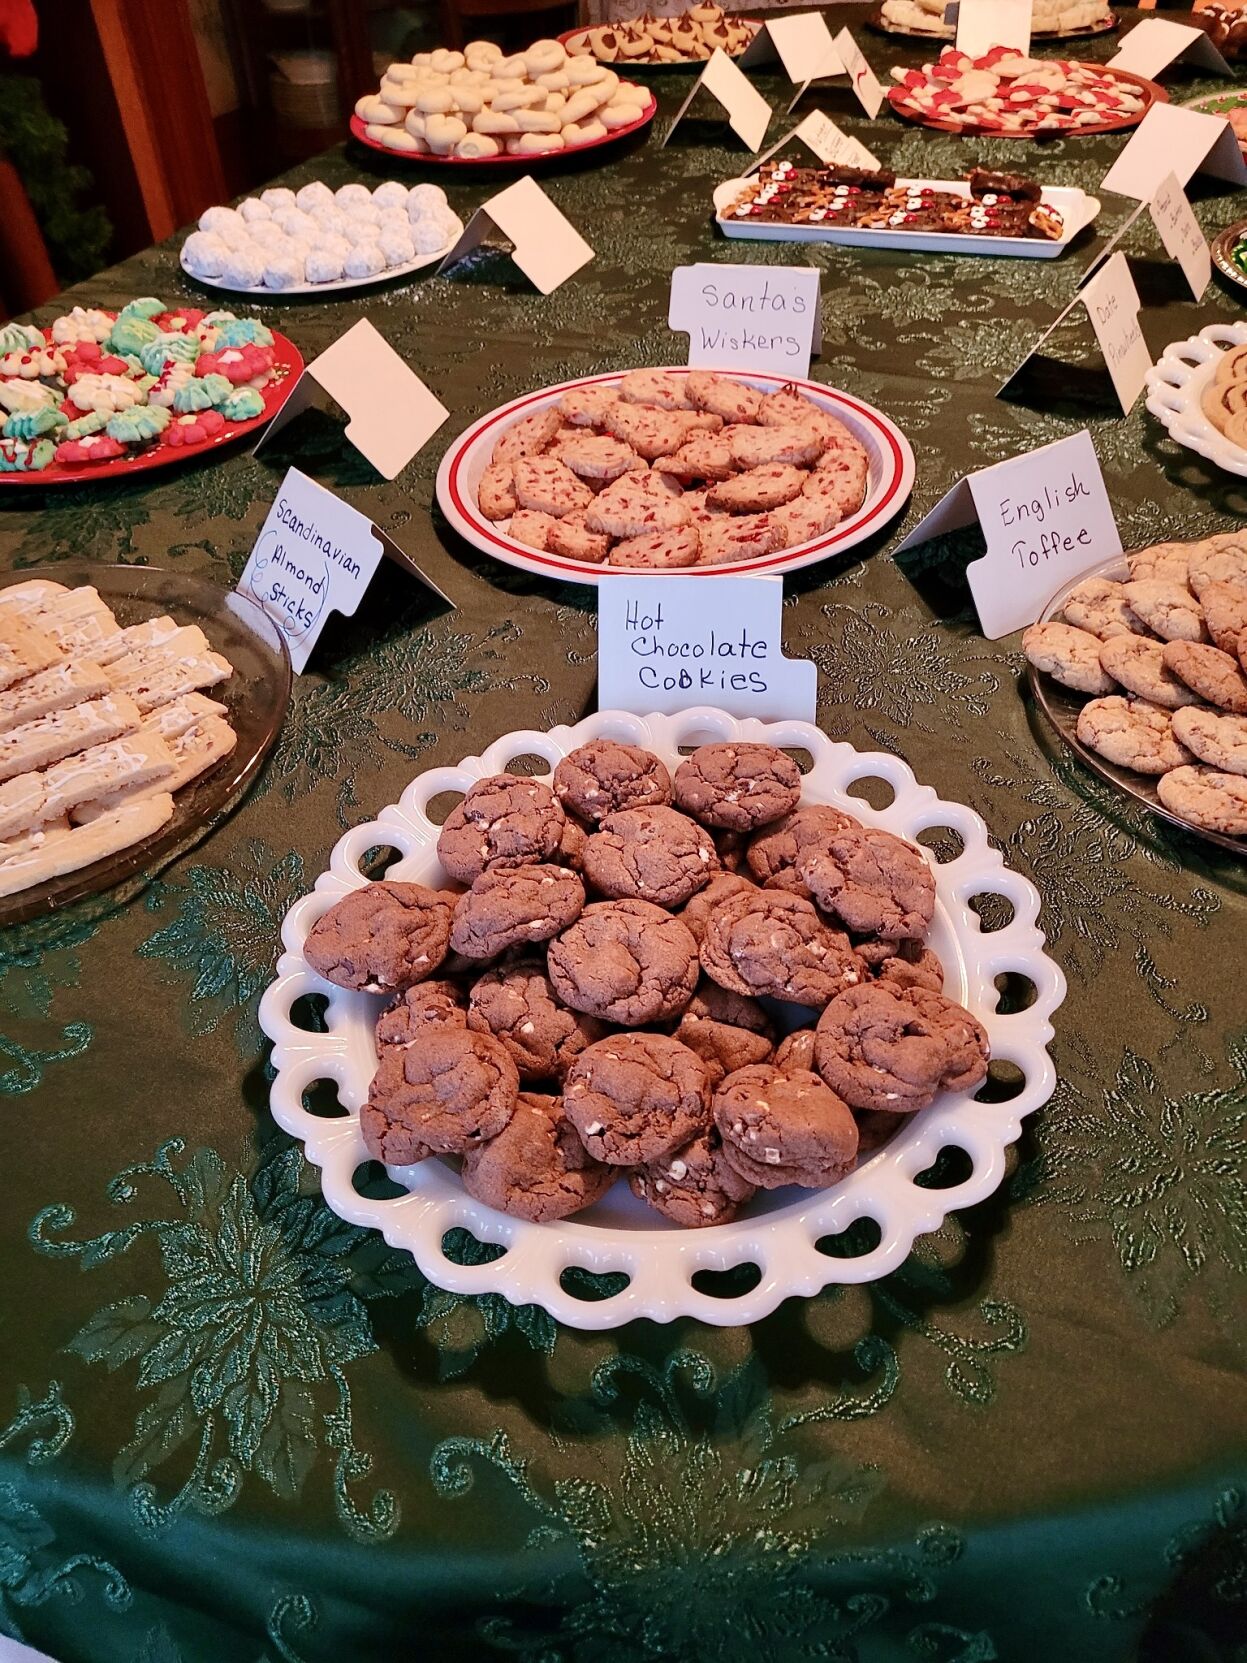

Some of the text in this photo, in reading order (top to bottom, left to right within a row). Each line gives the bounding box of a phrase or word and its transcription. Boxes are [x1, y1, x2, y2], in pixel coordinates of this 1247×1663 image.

[702, 281, 806, 313] Santa's
[1096, 294, 1118, 325] Date
[701, 327, 801, 356] Wiskers
[1000, 473, 1090, 527] English
[276, 498, 361, 580] Scandinavian
[1012, 528, 1092, 568] Toffee
[271, 544, 326, 594] Almond
[269, 582, 313, 628] Sticks
[625, 599, 664, 630] Hot
[631, 628, 768, 659] Chocolate
[638, 666, 768, 693] Cookies
